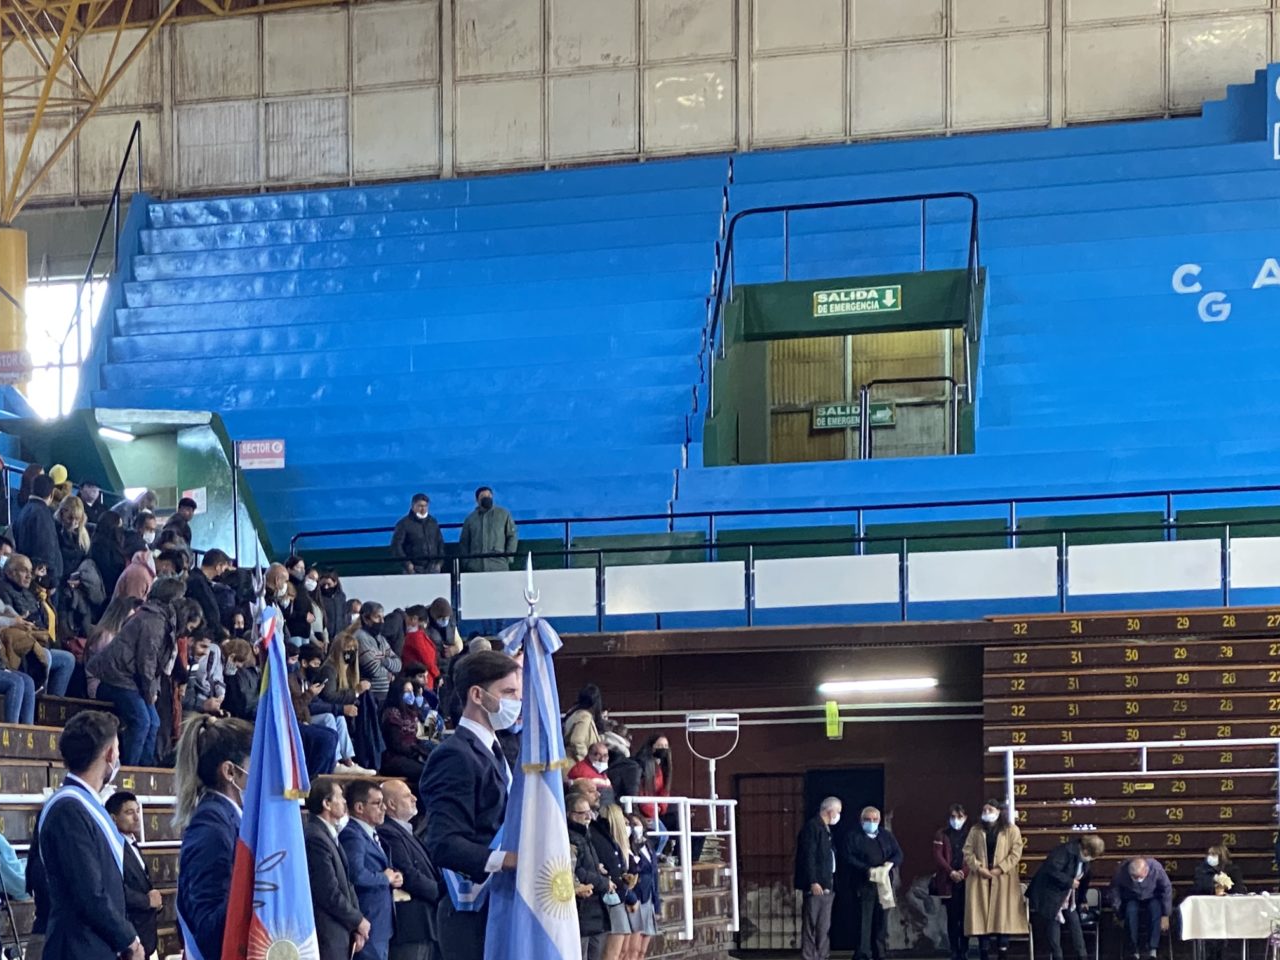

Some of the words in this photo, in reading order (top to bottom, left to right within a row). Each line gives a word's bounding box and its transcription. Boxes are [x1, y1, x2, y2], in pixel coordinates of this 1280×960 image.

[1172, 264, 1203, 294] C
[817, 289, 879, 303] SALIDA
[818, 304, 828, 313] DE
[830, 300, 880, 313] EMERGENCIA
[1198, 291, 1231, 322] G
[816, 405, 861, 416] SALID
[817, 417, 826, 426] DE
[827, 415, 861, 426] EMERGEN
[242, 442, 271, 454] SECTOR
[1127, 618, 1140, 631] 30
[1176, 617, 1190, 629] 29
[1222, 615, 1236, 628] 28
[1267, 614, 1280, 627] 27
[1013, 623, 1028, 635] 32
[1070, 620, 1082, 634] 31
[1013, 652, 1028, 664] 32
[1071, 650, 1082, 664] 31
[1125, 649, 1139, 661] 30
[1174, 647, 1187, 659] 29
[1010, 679, 1026, 691] 32
[1068, 677, 1080, 690] 31
[1125, 675, 1139, 688] 30
[1176, 673, 1190, 685] 29
[1011, 705, 1026, 717] 32
[1068, 703, 1079, 716] 31
[1125, 701, 1140, 715] 30
[1220, 699, 1234, 711] 28
[1061, 730, 1073, 742] 31
[1126, 729, 1140, 740] 30
[1217, 725, 1232, 737] 28
[1011, 732, 1027, 743] 32
[1064, 756, 1074, 768] 31
[1220, 752, 1233, 763] 28
[1014, 784, 1027, 795] 32
[1063, 783, 1074, 795] 31
[1122, 782, 1136, 794] 30
[1171, 780, 1186, 792] 29
[1221, 779, 1234, 791] 28
[1168, 807, 1183, 819] 29
[1220, 807, 1233, 818] 28
[1117, 835, 1131, 847] 30
[1166, 833, 1181, 845] 29
[1222, 833, 1237, 845] 28
